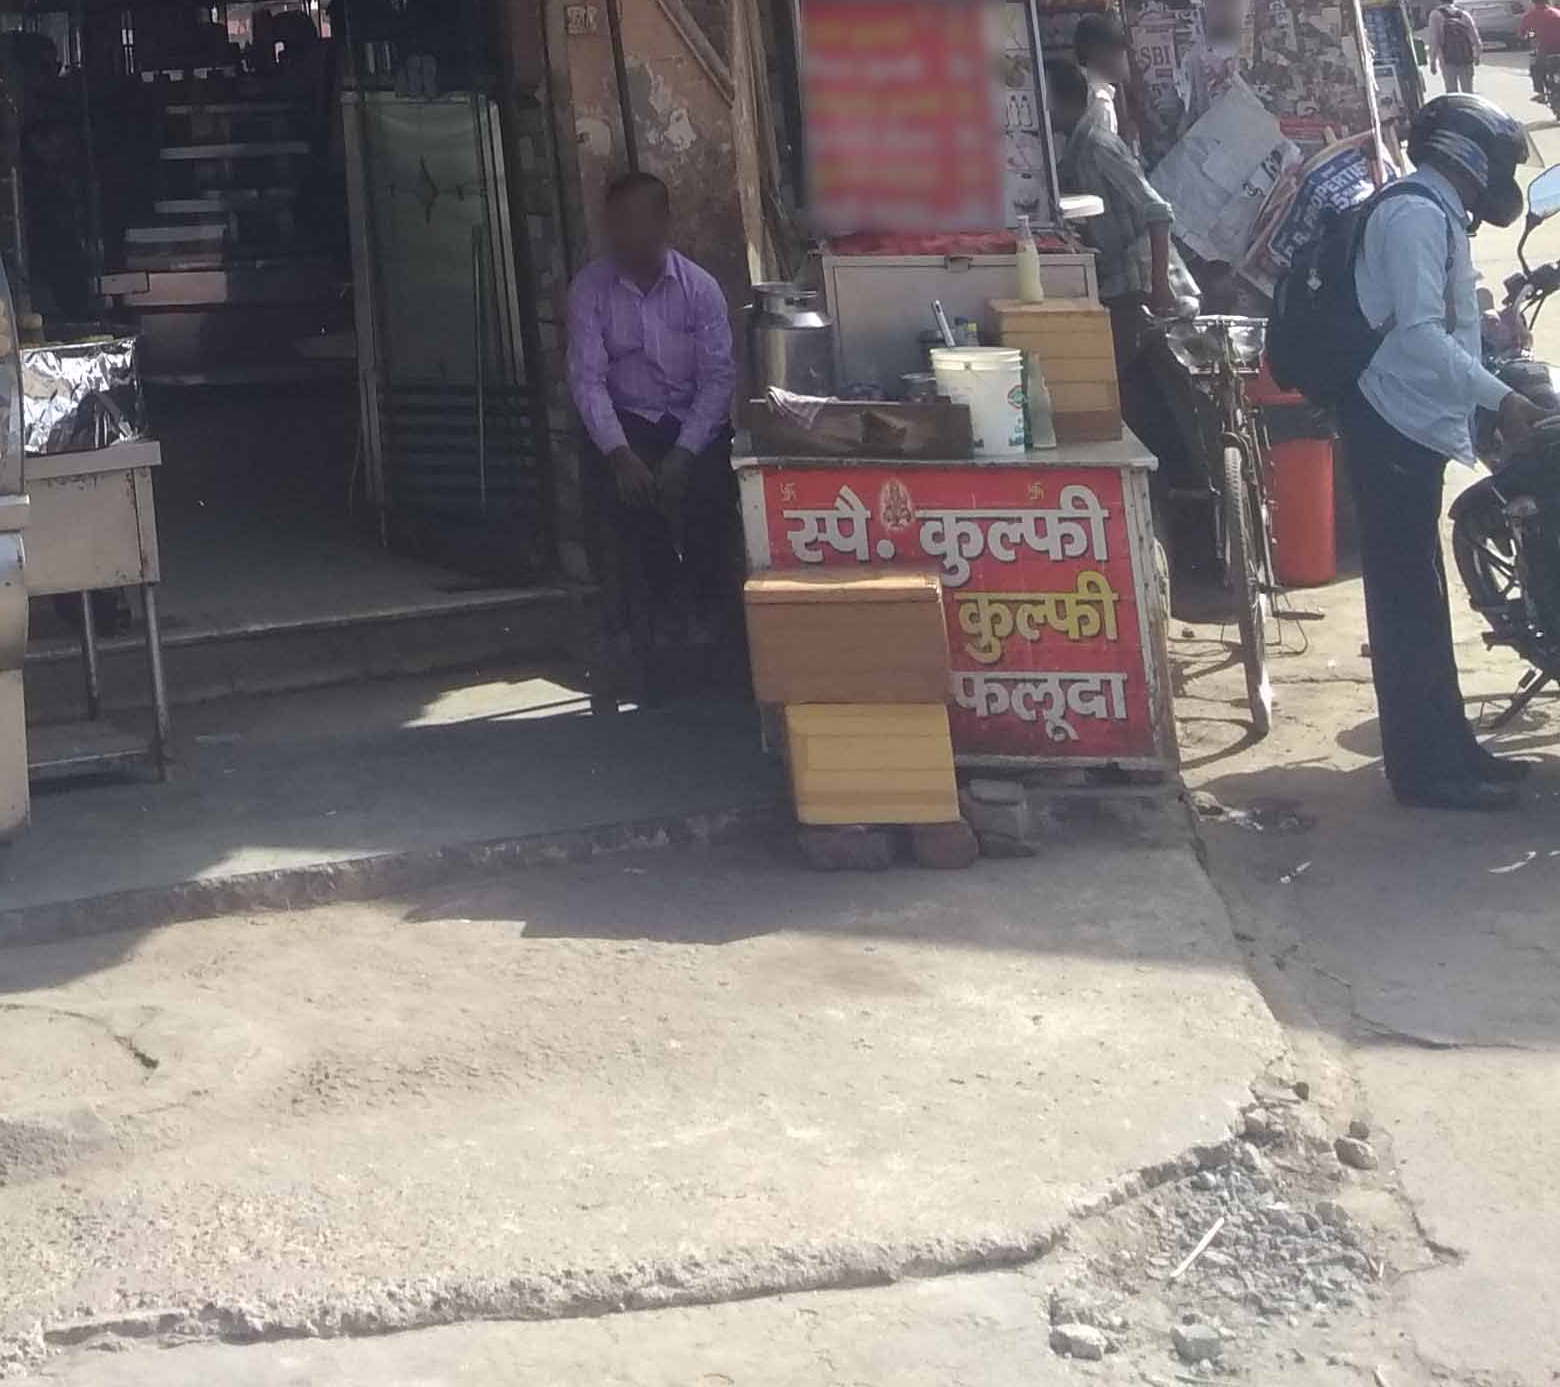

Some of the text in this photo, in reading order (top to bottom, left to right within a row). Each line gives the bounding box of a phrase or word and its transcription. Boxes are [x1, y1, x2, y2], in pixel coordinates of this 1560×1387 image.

[1140, 45, 1170, 68] SBI
[912, 484, 1109, 588] कुल्फी
[952, 570, 1120, 664] कुल्फी
